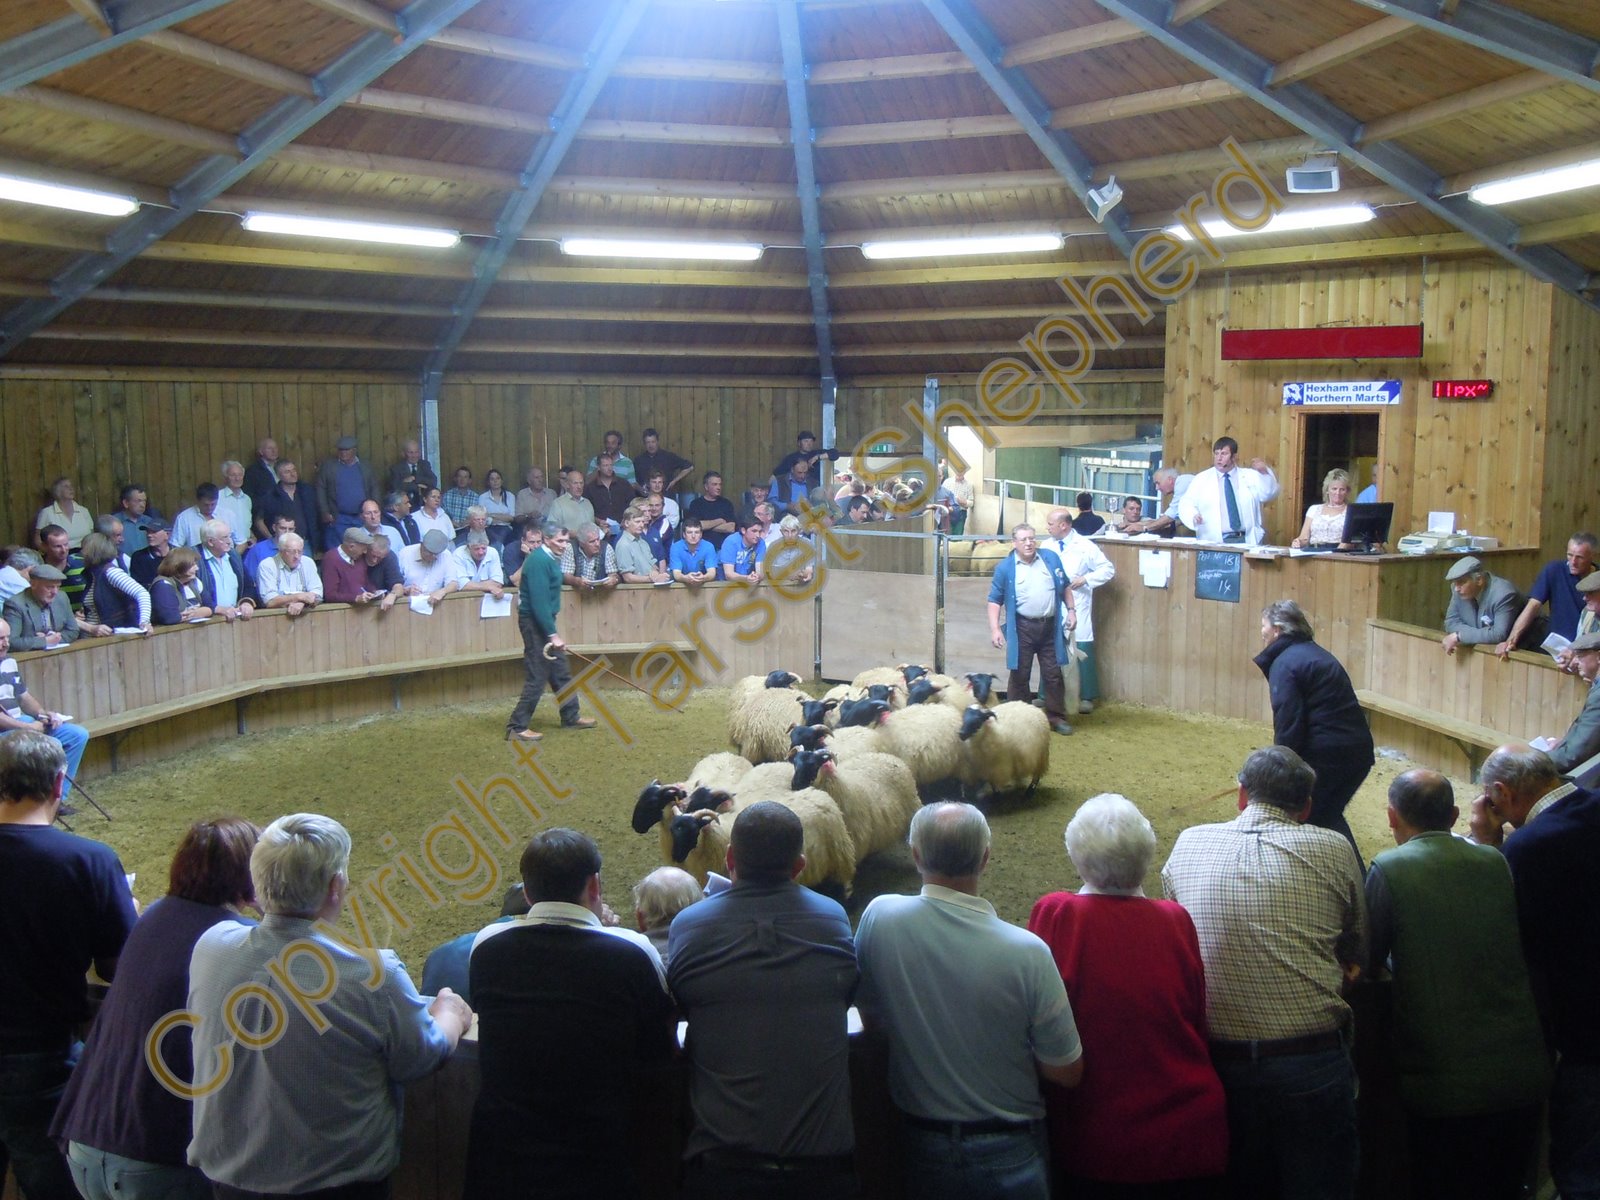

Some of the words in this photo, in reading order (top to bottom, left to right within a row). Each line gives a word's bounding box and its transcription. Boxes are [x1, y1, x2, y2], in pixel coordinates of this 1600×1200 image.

[1306, 384, 1349, 393] Hexham
[1352, 384, 1372, 392] and
[1306, 394, 1352, 403] Northern
[1355, 394, 1386, 402] Marts
[1218, 579, 1232, 595] 14
